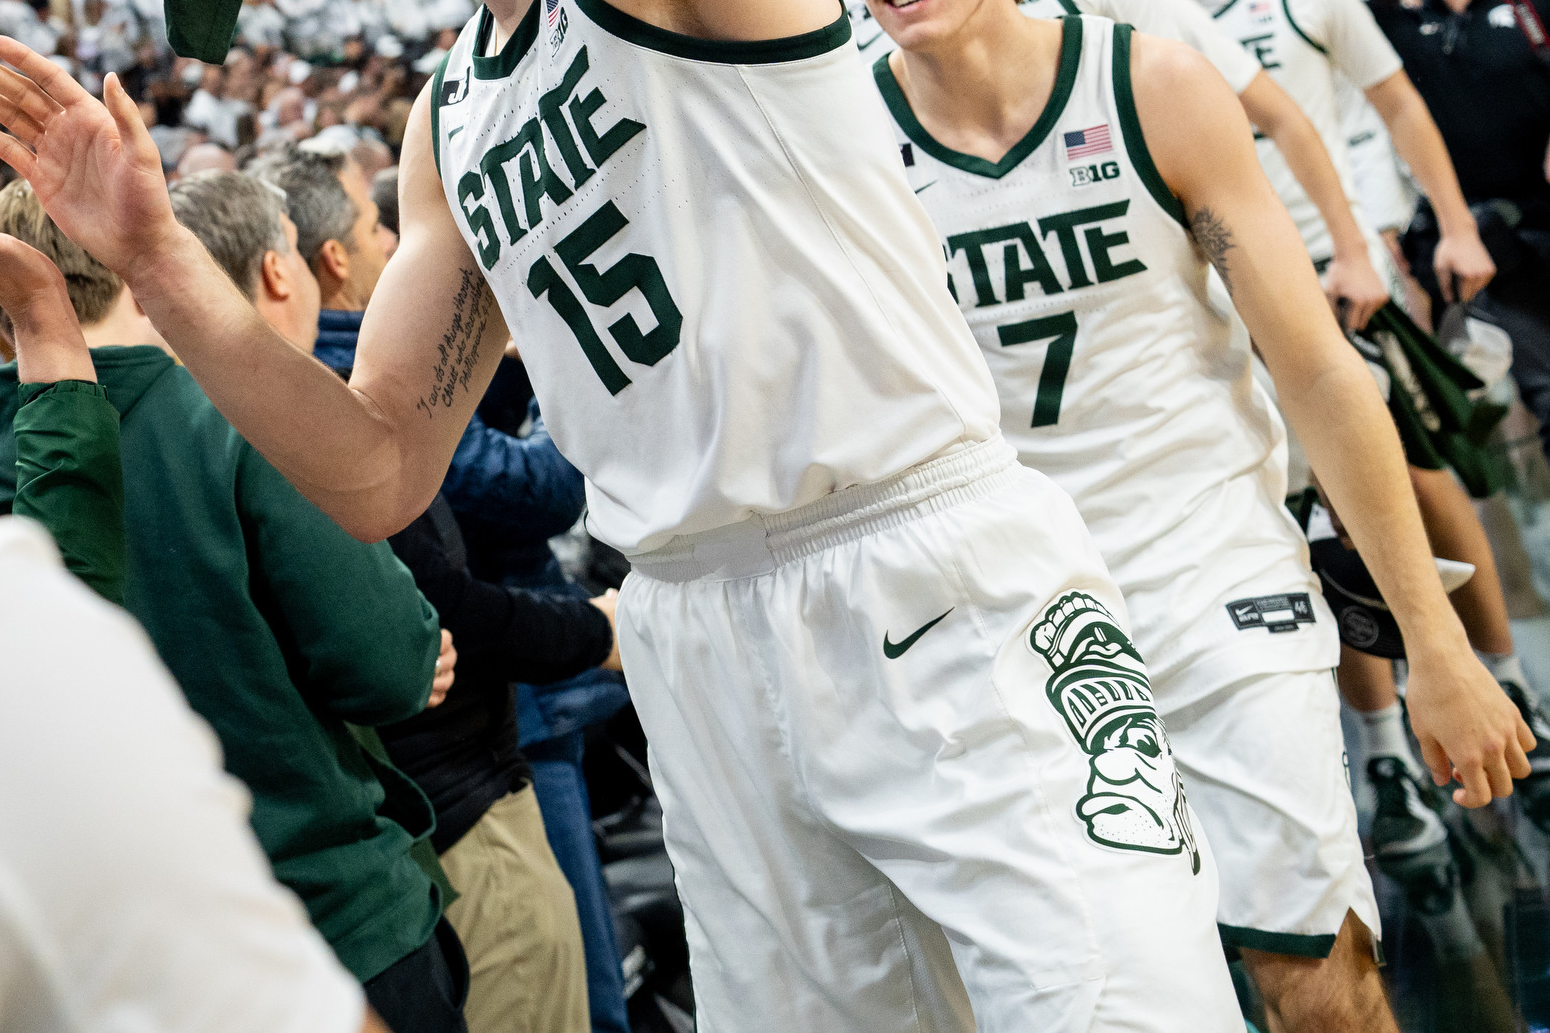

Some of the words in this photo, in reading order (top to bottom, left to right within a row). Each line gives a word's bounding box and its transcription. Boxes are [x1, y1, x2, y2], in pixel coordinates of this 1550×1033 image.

[457, 43, 647, 272] STATE
[452, 266, 474, 314] through
[526, 199, 683, 397] 15
[443, 311, 465, 351] things
[434, 365, 446, 384] do
[437, 343, 450, 368] all
[441, 365, 460, 408] Christ
[456, 338, 468, 366] who
[996, 309, 1079, 429] 7
[428, 384, 442, 407] can
